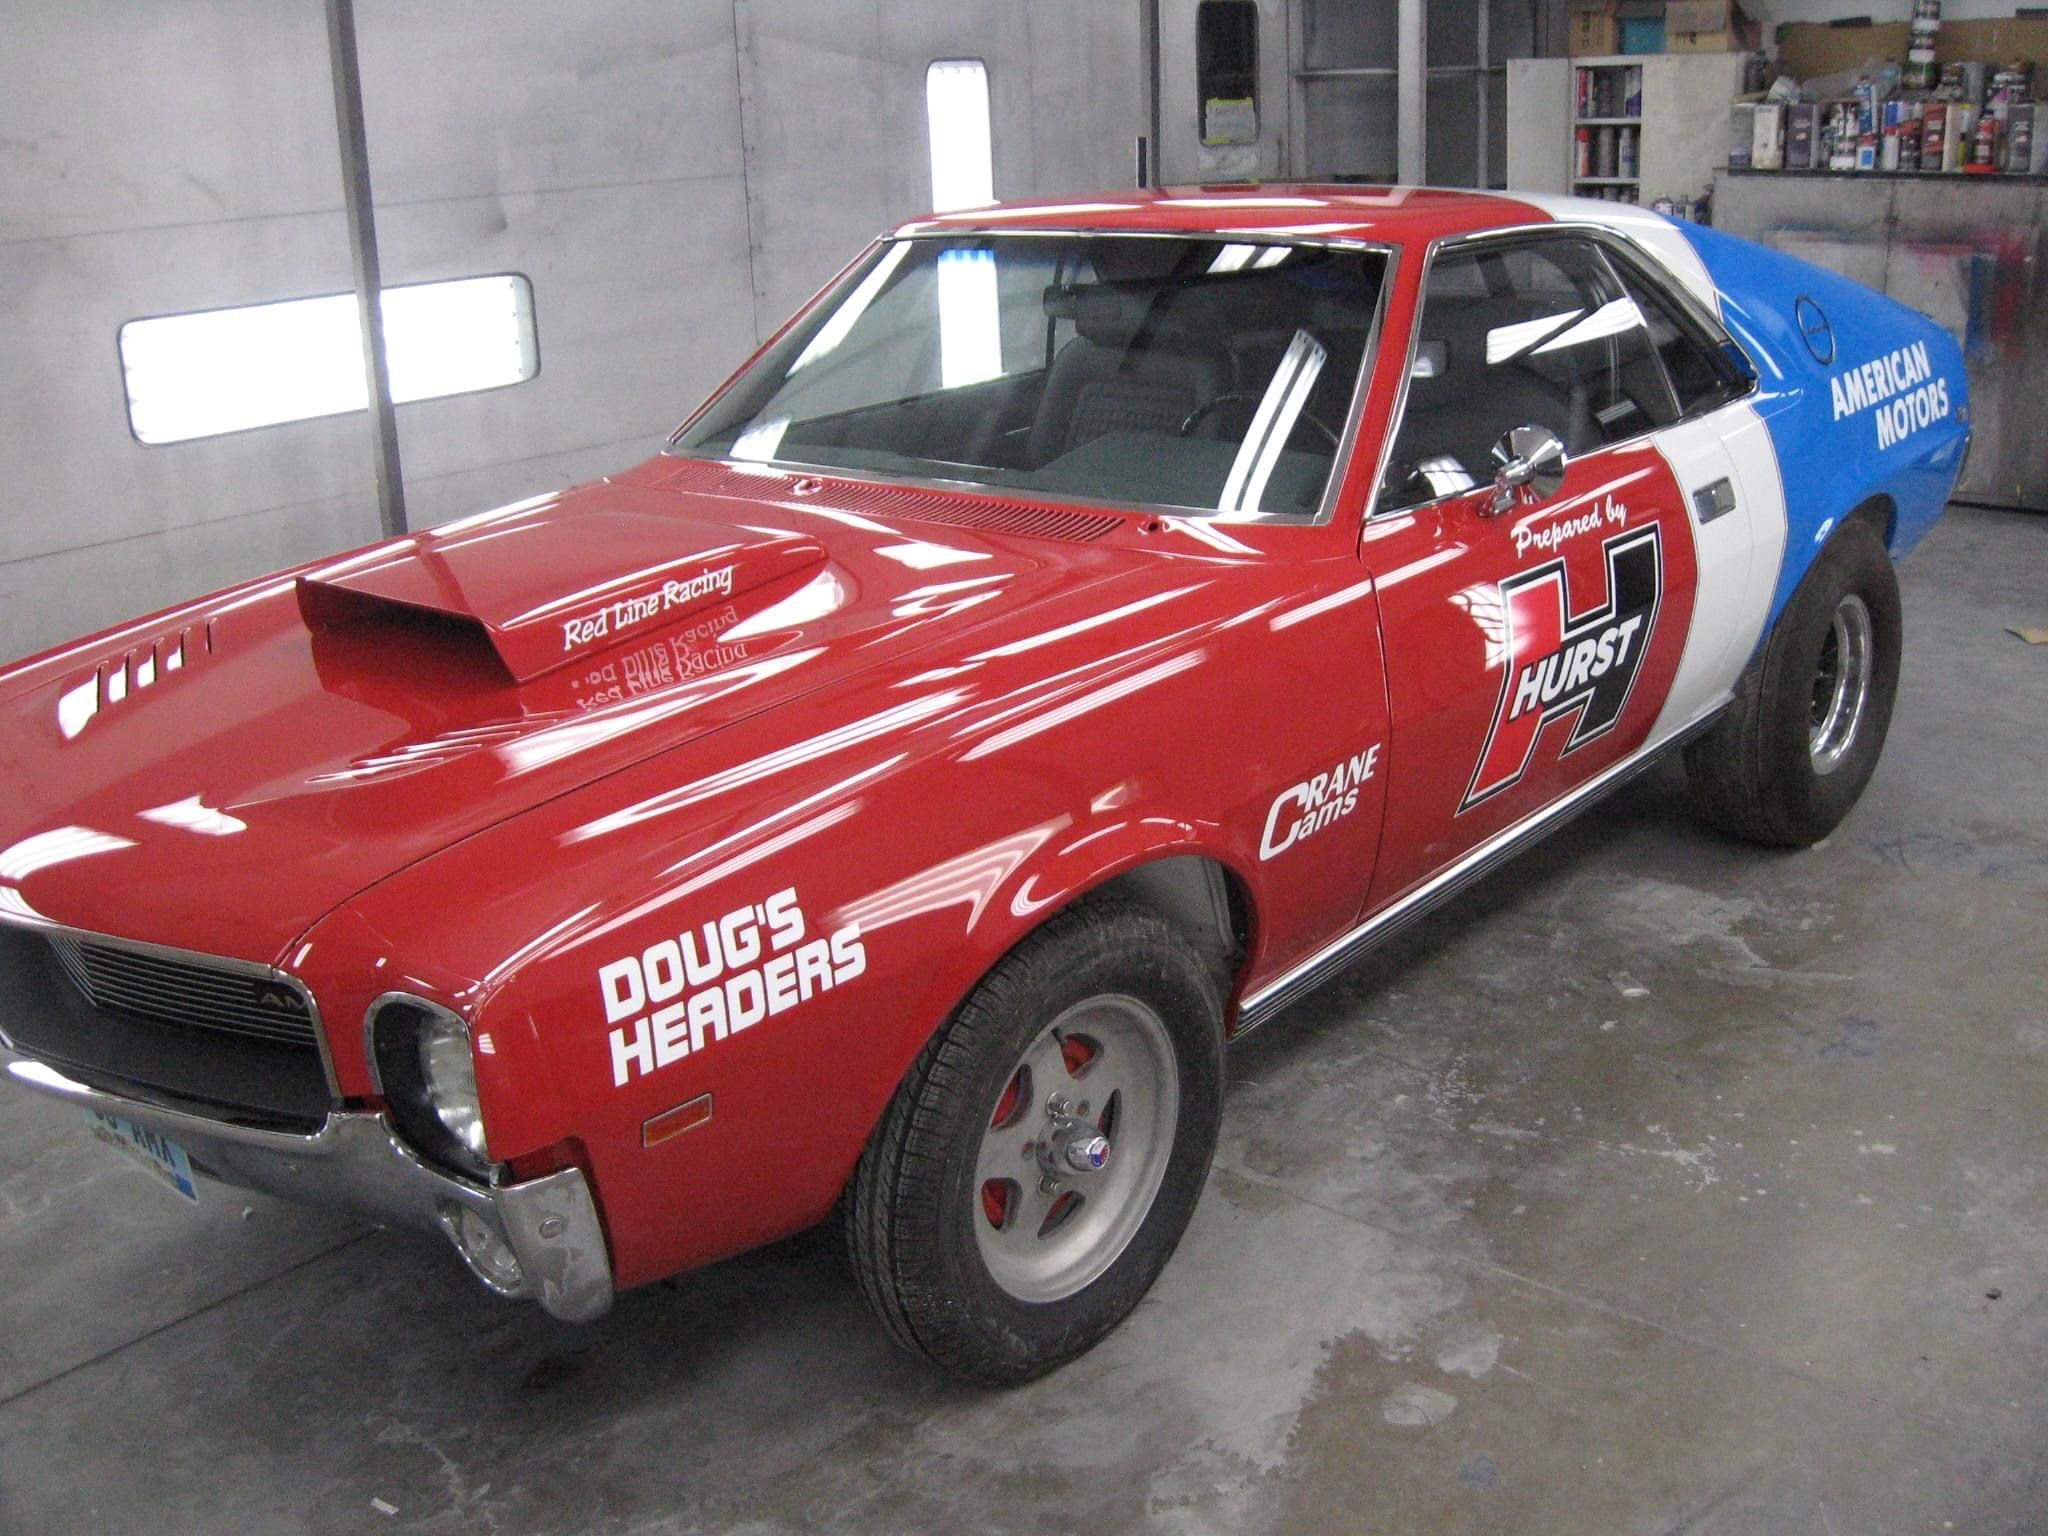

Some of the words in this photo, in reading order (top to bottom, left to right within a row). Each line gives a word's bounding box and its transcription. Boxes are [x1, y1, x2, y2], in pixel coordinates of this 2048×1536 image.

[1831, 340, 1931, 421] AMERICAN
[1875, 378, 1948, 450] MOTORS
[1510, 502, 1602, 559] Prepared
[1606, 494, 1627, 528] by
[563, 608, 609, 650] Red
[614, 598, 659, 630] Line
[662, 565, 734, 610] Racing
[1509, 614, 1642, 721] HURST
[598, 886, 806, 1024] DOUG'S
[608, 922, 867, 1088] HEADERS
